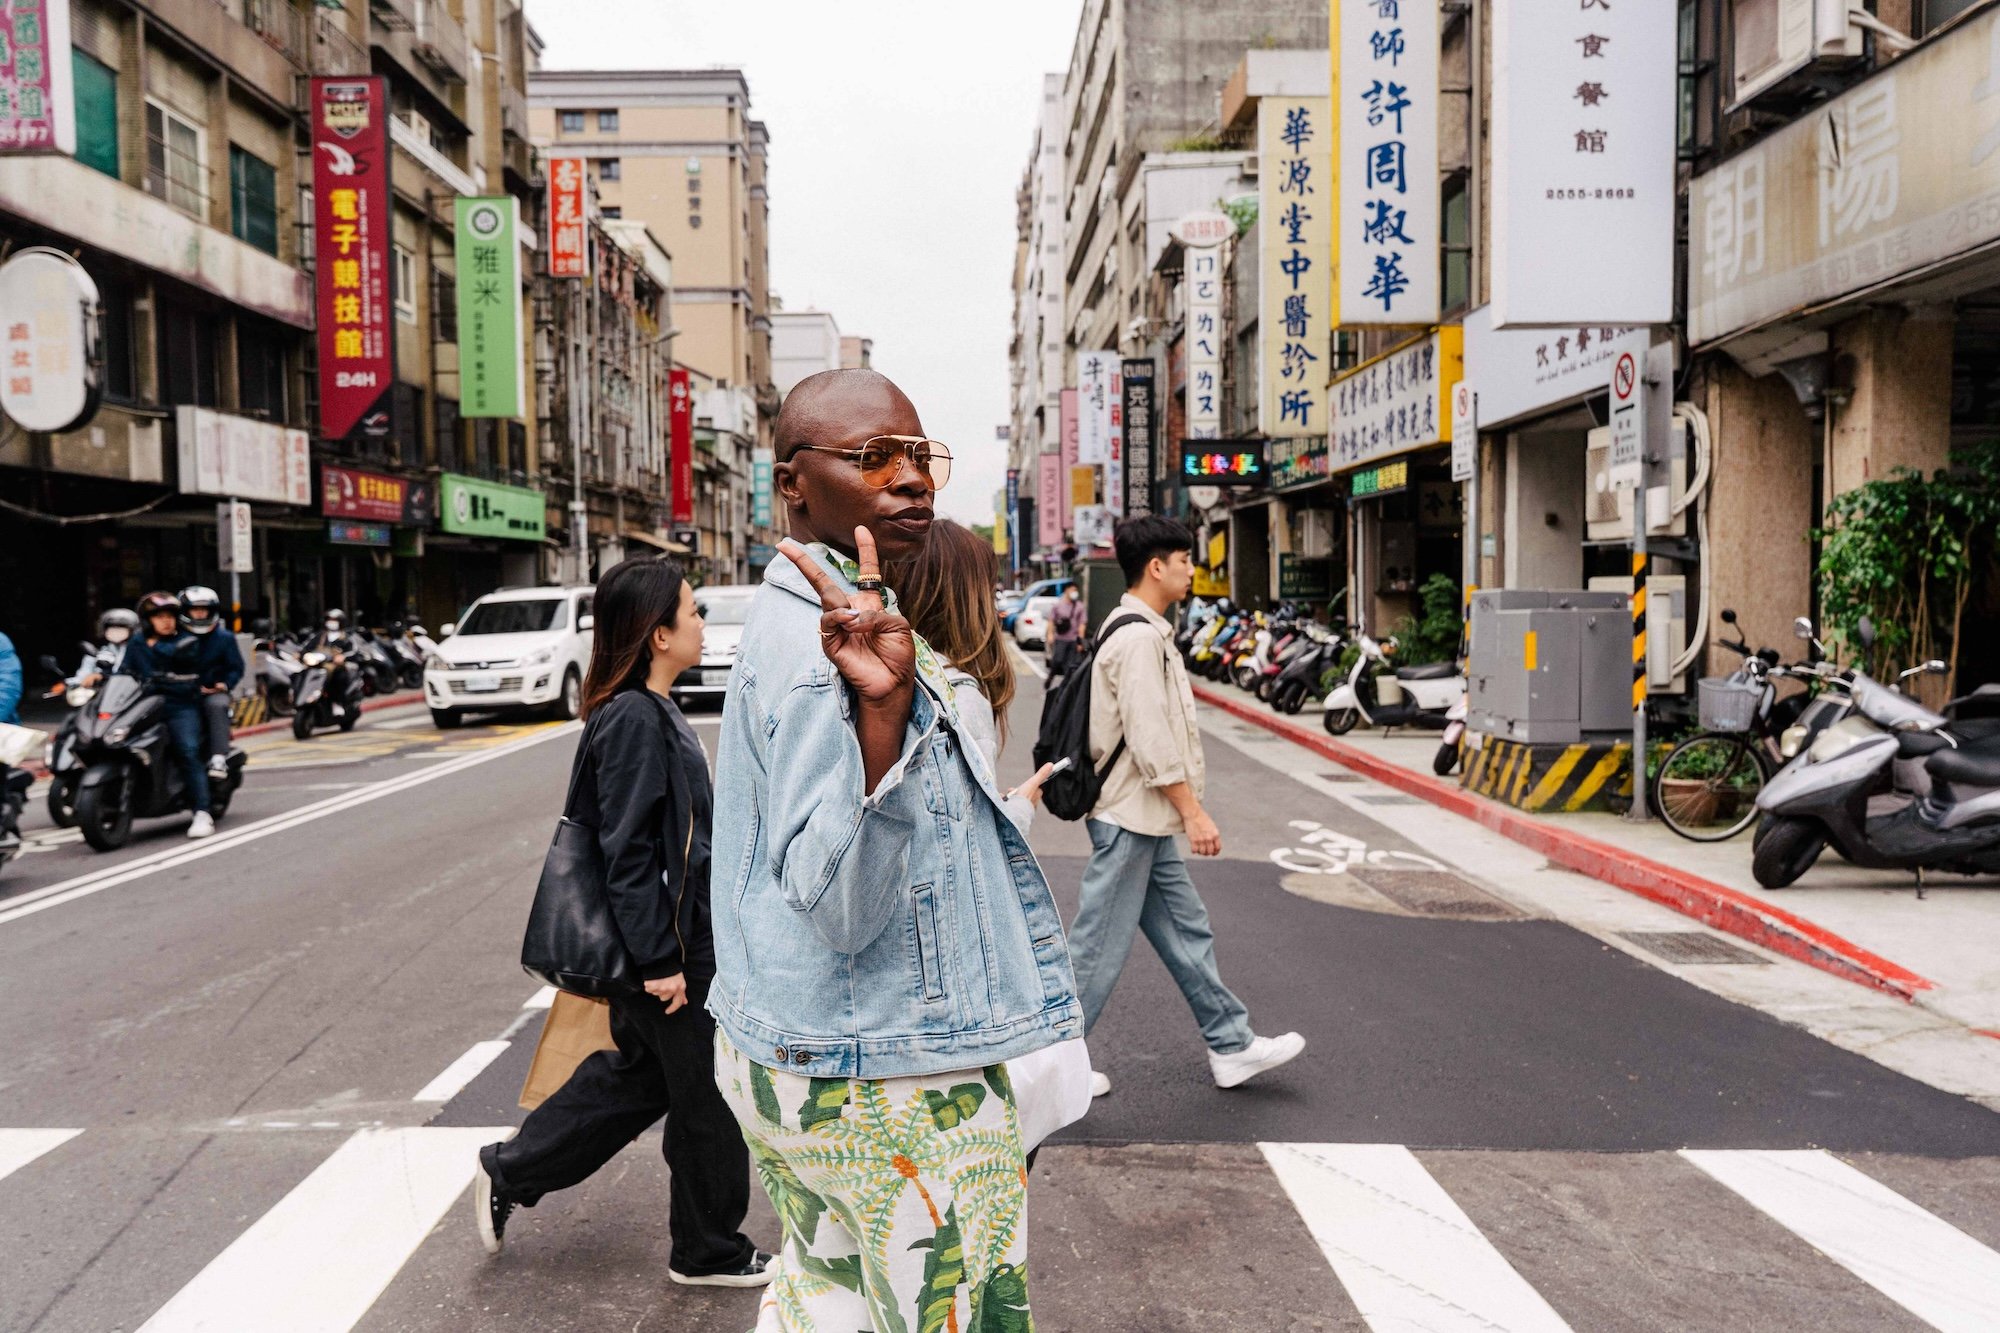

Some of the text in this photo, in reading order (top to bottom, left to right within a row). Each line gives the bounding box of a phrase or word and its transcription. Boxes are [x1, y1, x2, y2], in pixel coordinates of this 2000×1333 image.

[330, 189, 363, 358] 電子競技館
[473, 246, 500, 307] 雅米
[1279, 107, 1317, 426] 華源堂中醫診所
[336, 372, 376, 388] 24H
